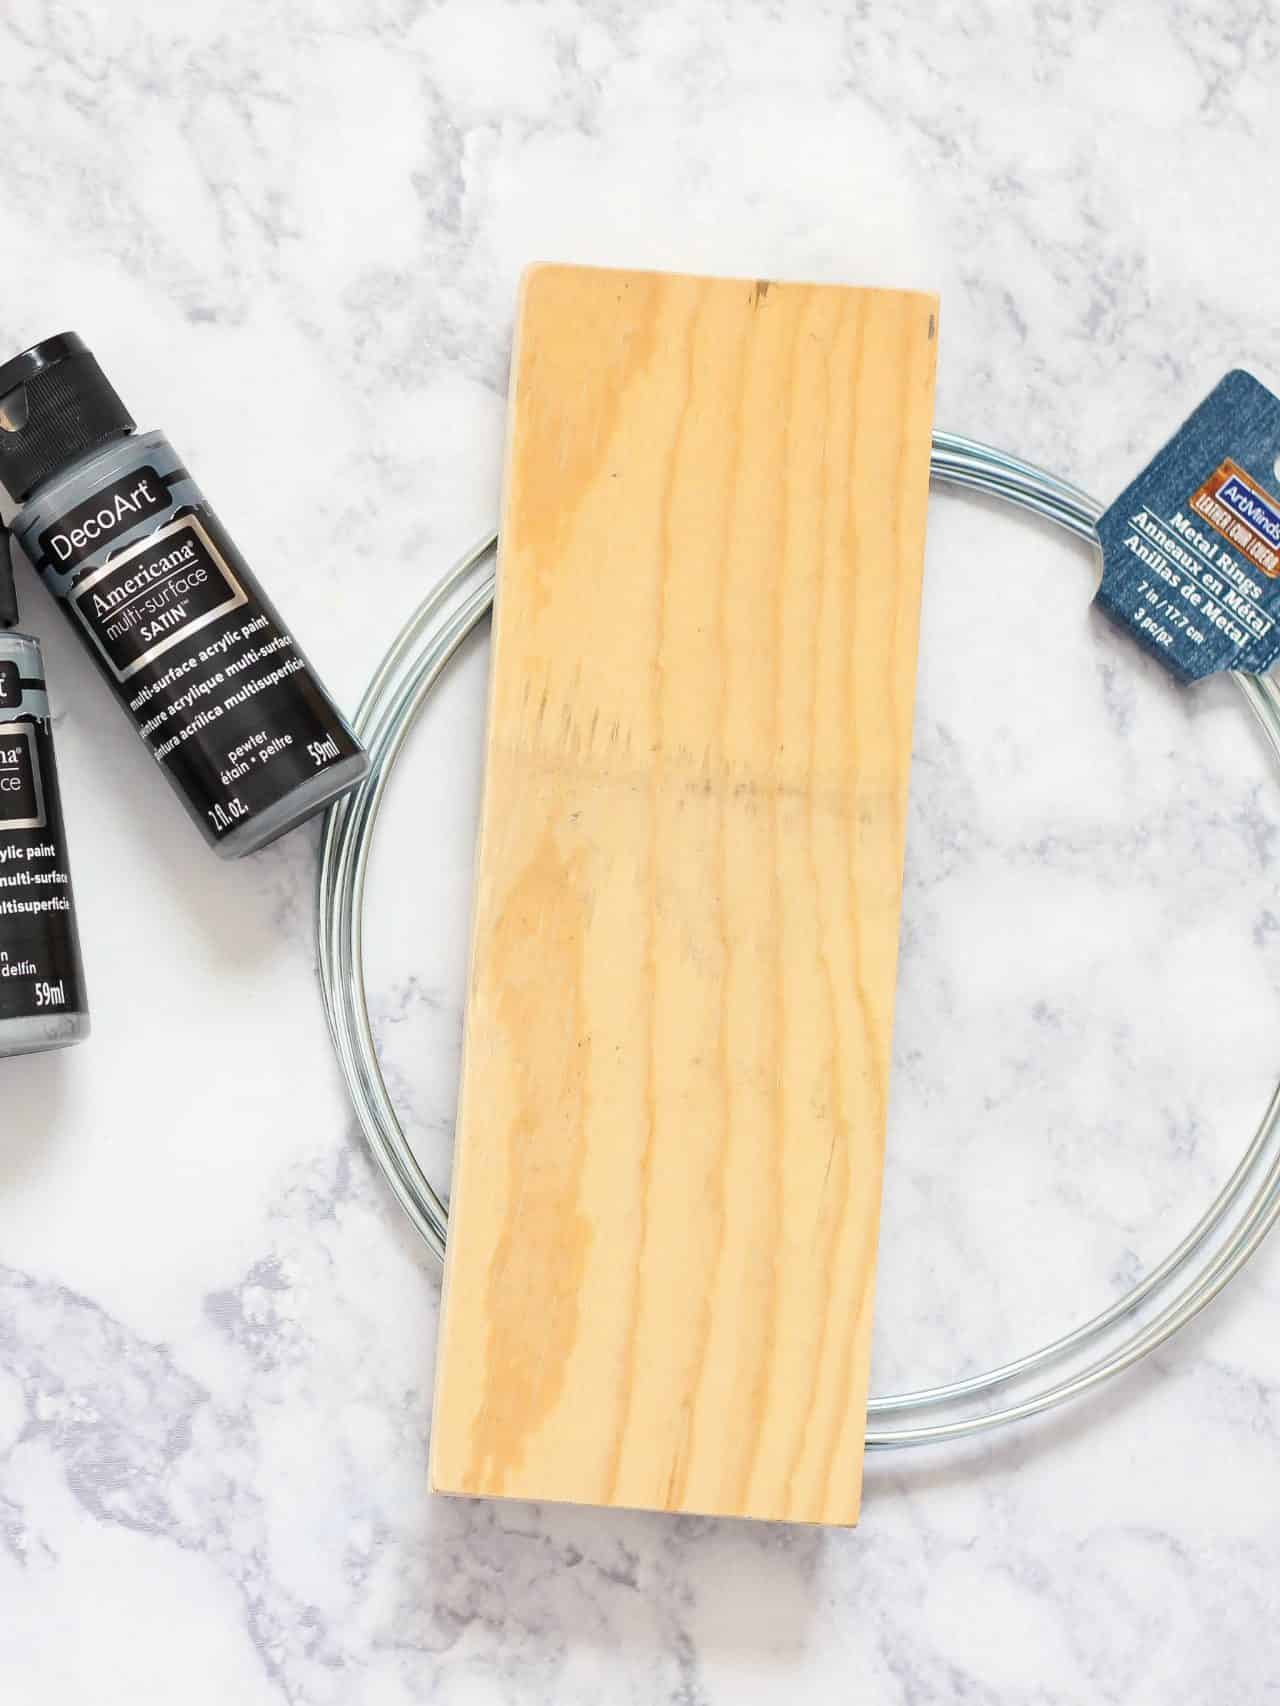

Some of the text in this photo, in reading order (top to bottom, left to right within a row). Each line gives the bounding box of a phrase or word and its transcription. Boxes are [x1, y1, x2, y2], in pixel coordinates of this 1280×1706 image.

[1132, 512, 1271, 637] Anneaux en Métal
[1170, 512, 1263, 600] Metal Rings
[106, 568, 208, 640] multi-surface
[1124, 534, 1250, 648] Anillas de Metal
[1134, 607, 1143, 620] 3
[1137, 580, 1147, 593] 7
[1144, 587, 1159, 605] in
[1164, 601, 1190, 628] 17.7
[1186, 627, 1205, 645] cm
[130, 616, 269, 711] multi-surface acrylic paint
[168, 673, 224, 716] acrylique
[180, 706, 224, 740] acrílica
[221, 733, 294, 785] étain peltre
[228, 731, 269, 765] pewter
[307, 734, 340, 766] 59ml
[208, 809, 222, 831] 2
[27, 844, 55, 860] paint
[2, 960, 36, 976] delfín
[35, 980, 64, 1006] 59ml
